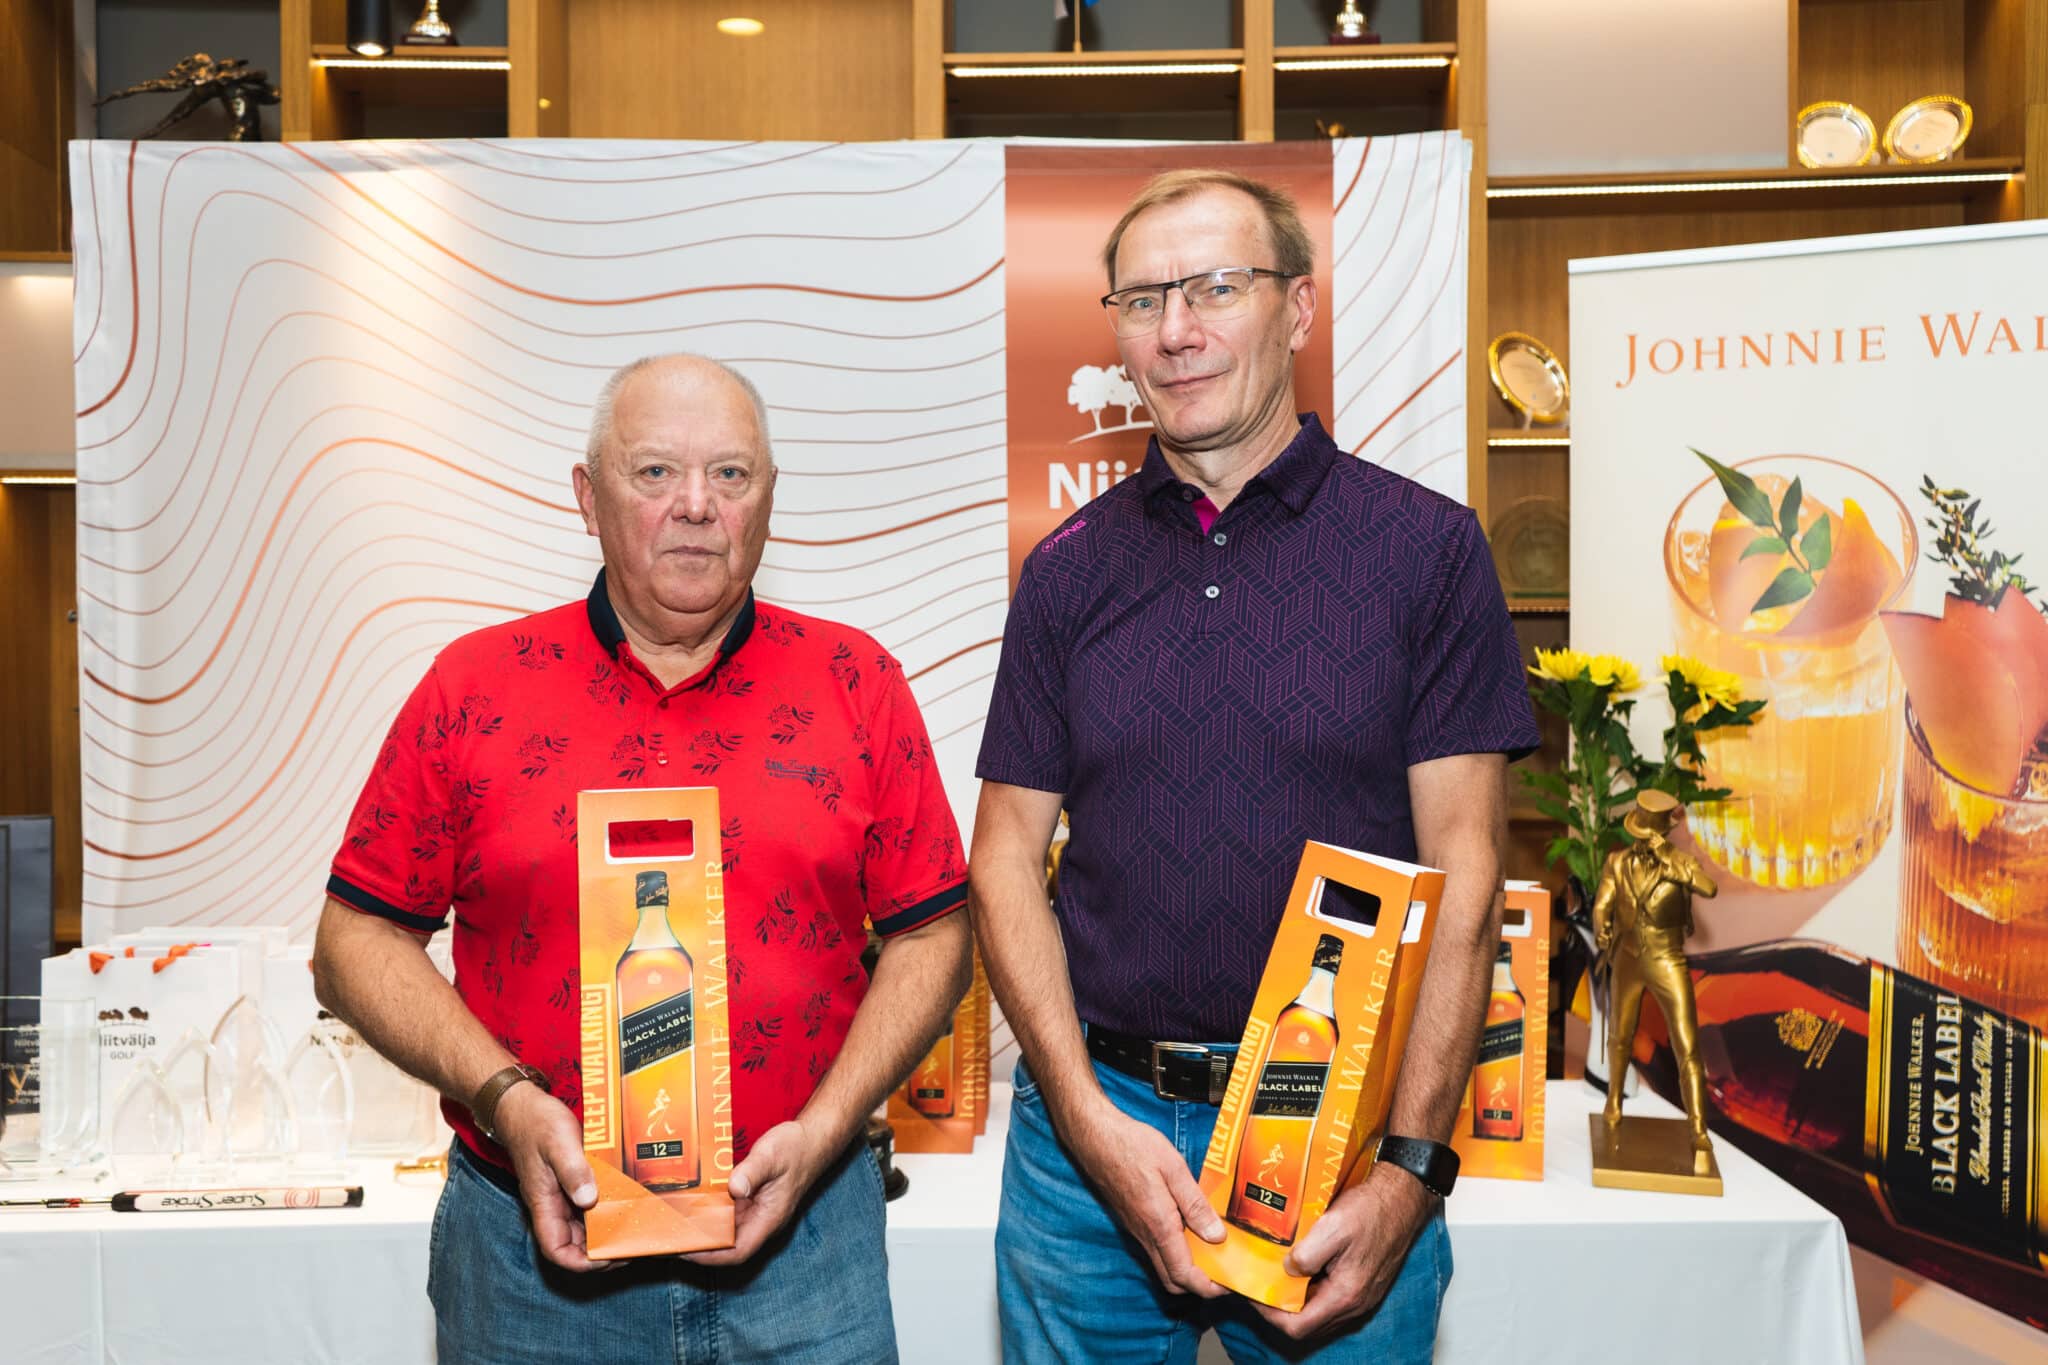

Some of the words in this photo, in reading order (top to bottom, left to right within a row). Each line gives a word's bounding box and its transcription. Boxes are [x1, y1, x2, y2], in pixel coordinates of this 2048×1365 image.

[1615, 325, 1887, 389] JOHNNIE
[1048, 460, 1143, 510] Nii
[1053, 519, 1088, 544] PING
[581, 988, 605, 1087] WALKING
[621, 1028, 657, 1049] BLACK
[658, 1014, 694, 1033] LABEL
[1480, 1038, 1499, 1049] LACK
[1934, 993, 1963, 1085] LABEL
[1205, 1118, 1232, 1165] KEEP
[1222, 1024, 1263, 1113] WALKING
[1257, 1083, 1289, 1092] BLACK
[1291, 1084, 1324, 1093] LABEL
[583, 1092, 607, 1143] KEEP
[1905, 1082, 1925, 1156] JOHNNIE
[652, 1143, 668, 1157] 12
[1931, 1092, 1961, 1195] BLACK
[1260, 1189, 1273, 1205] 12
